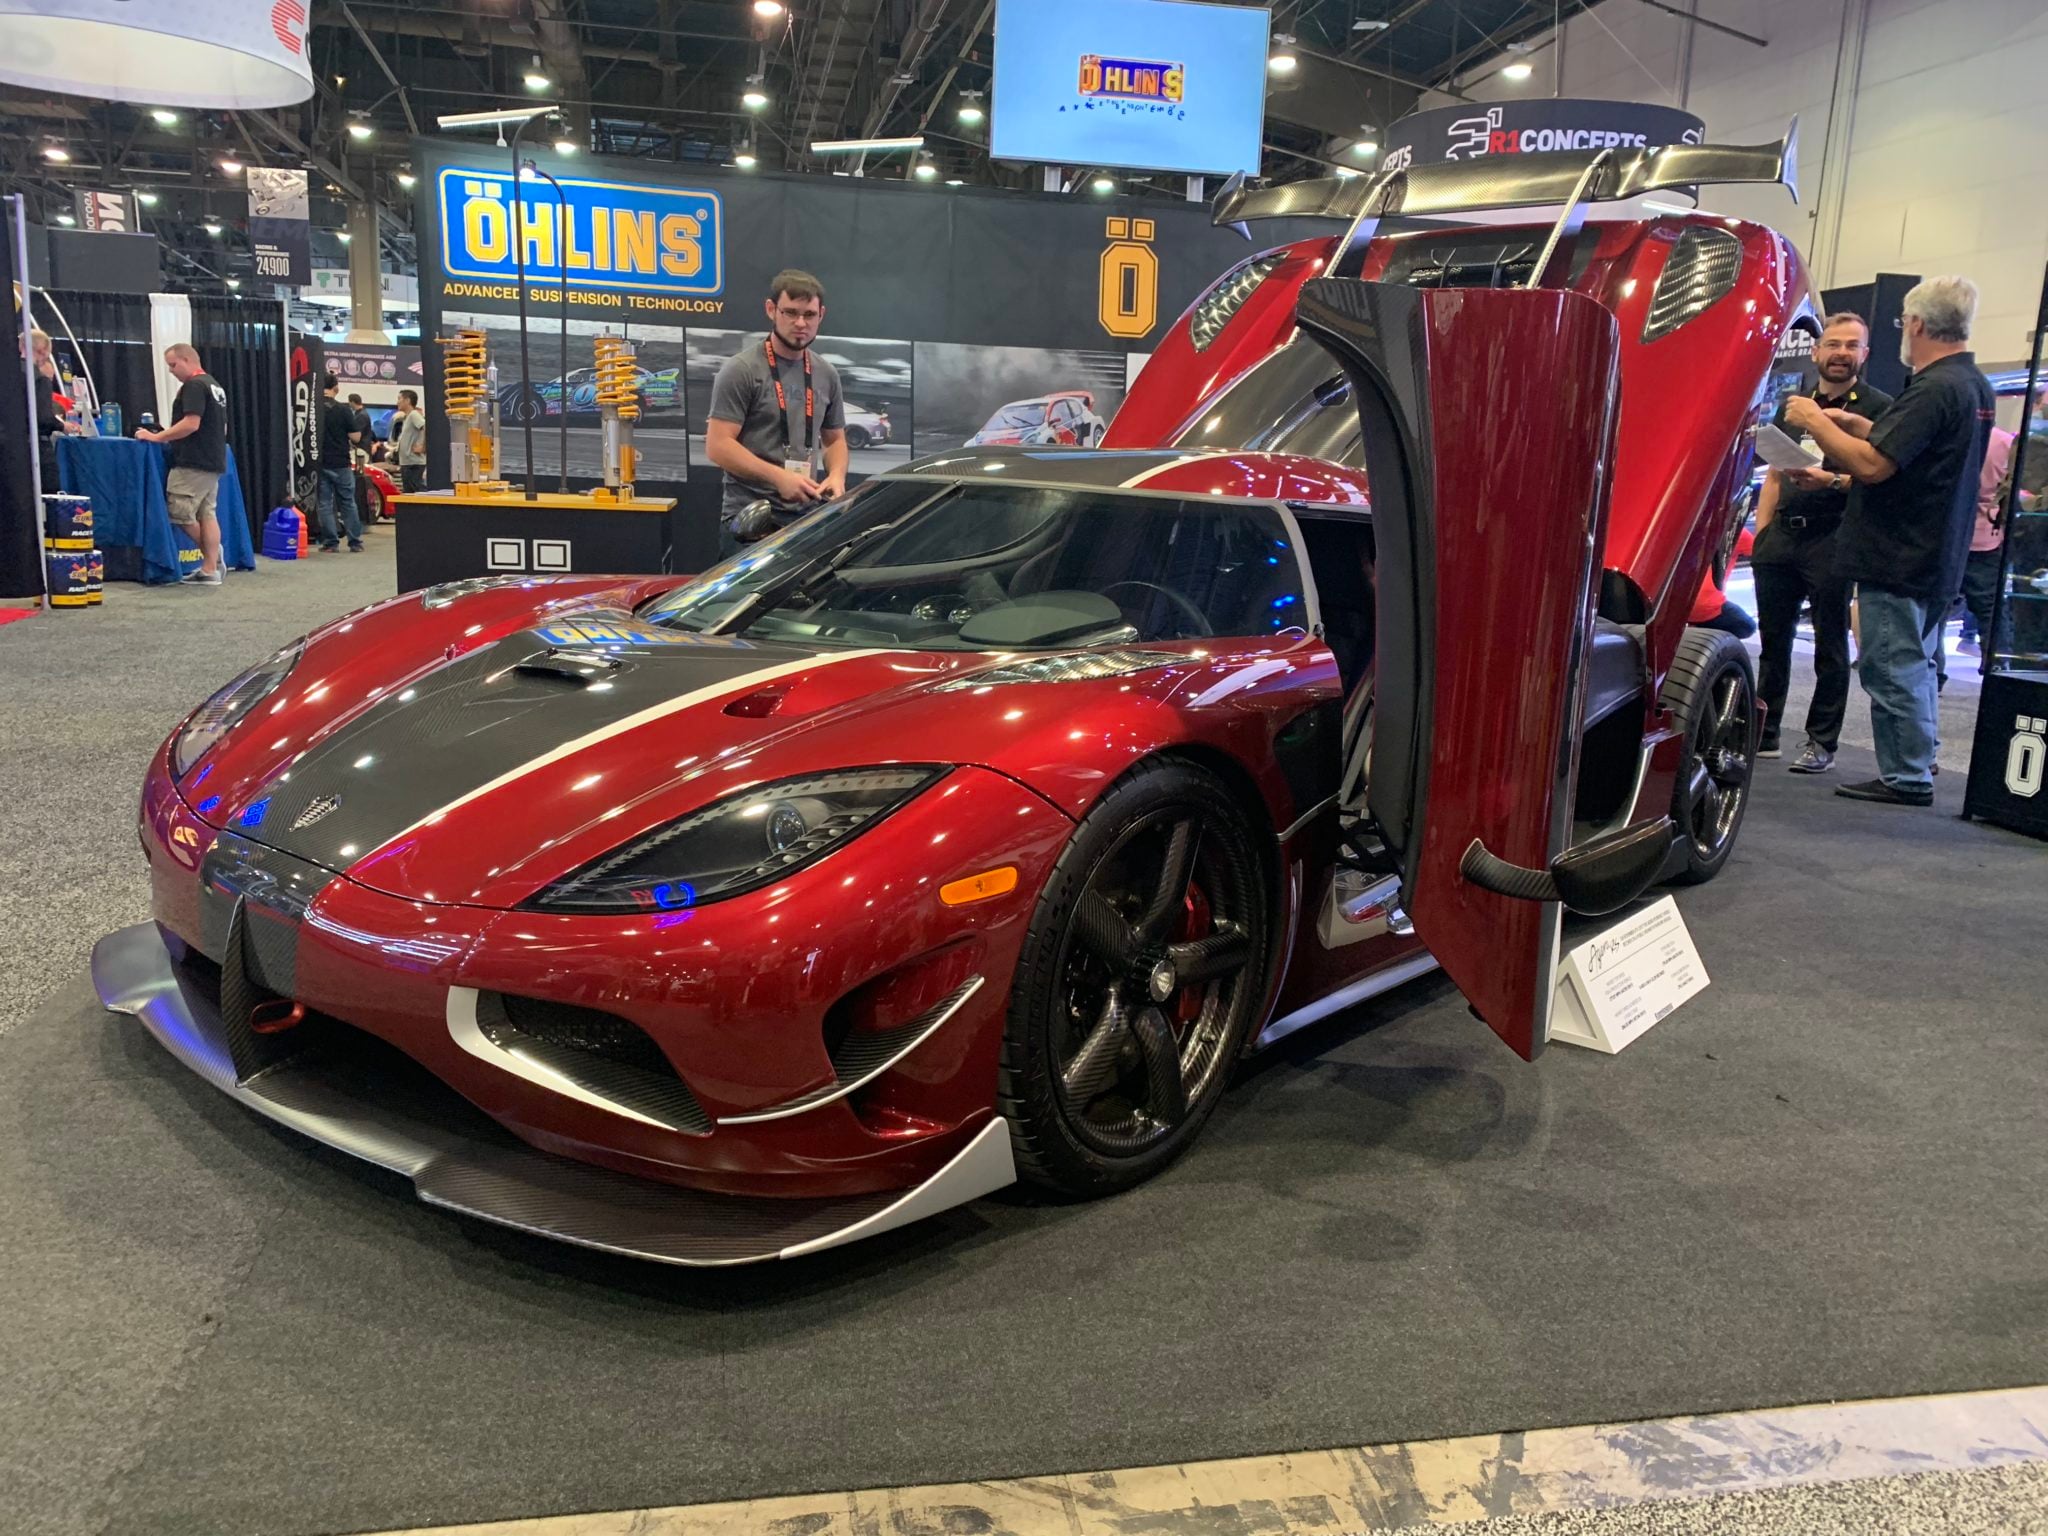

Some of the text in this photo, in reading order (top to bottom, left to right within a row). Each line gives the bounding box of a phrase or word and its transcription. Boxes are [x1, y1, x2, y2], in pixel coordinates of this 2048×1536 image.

[463, 180, 702, 277] ÖHLINS
[256, 256, 290, 277] 24900
[627, 295, 724, 314] TECHNOLOGY
